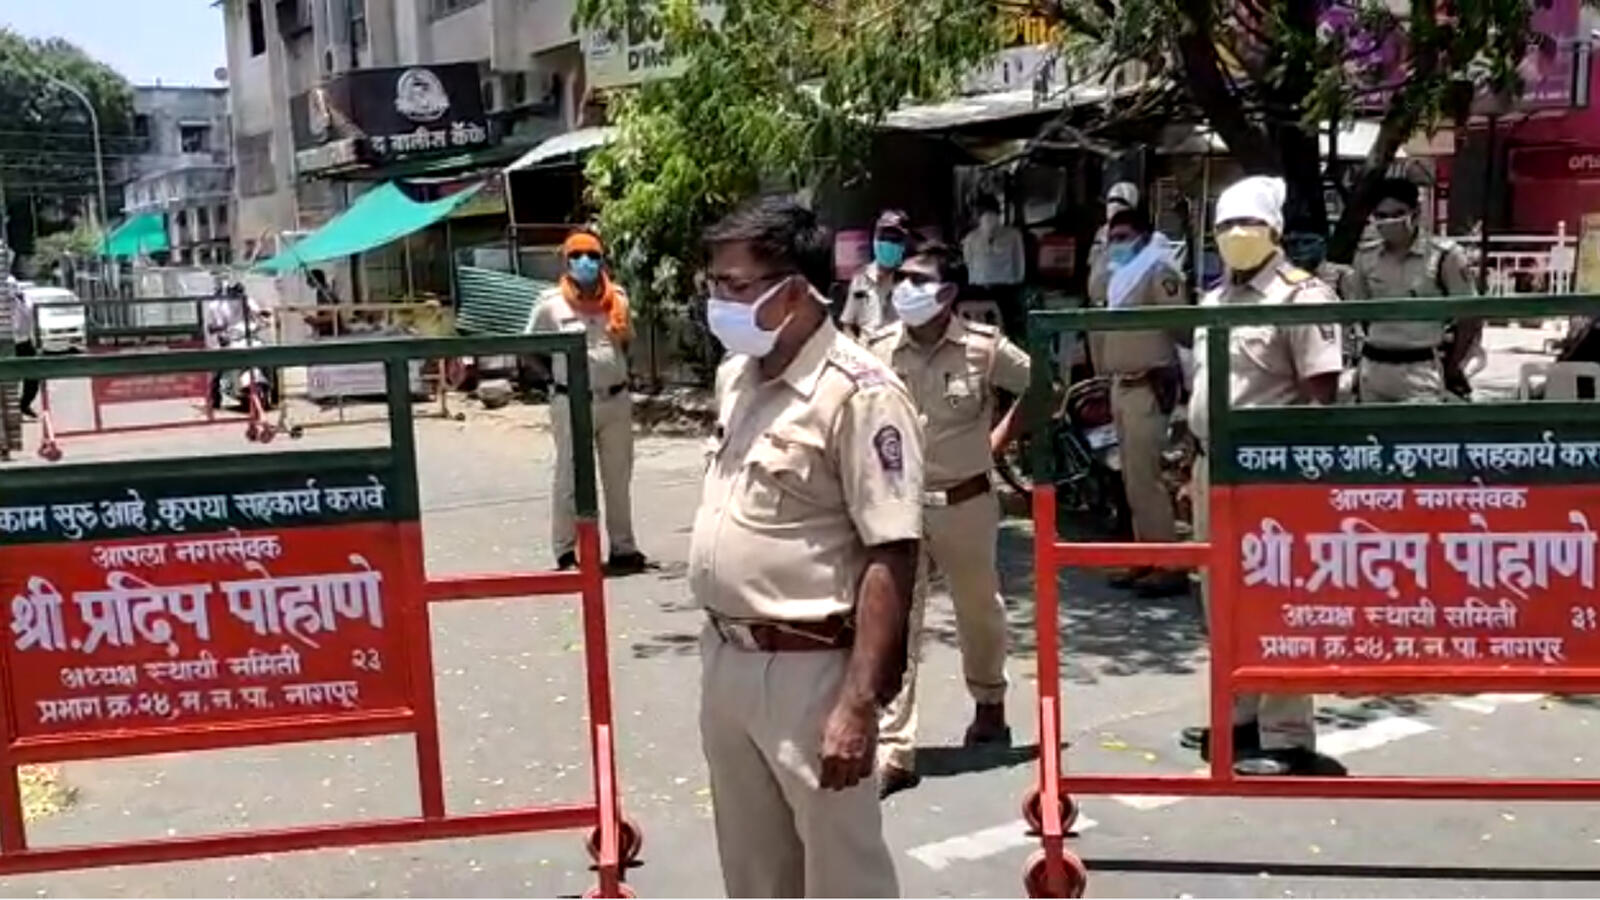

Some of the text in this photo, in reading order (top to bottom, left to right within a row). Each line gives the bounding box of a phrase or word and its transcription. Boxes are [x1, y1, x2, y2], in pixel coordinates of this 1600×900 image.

[1237, 446, 1288, 471] काम
[1292, 446, 1335, 480] सुरु
[1464, 430, 1557, 474] सहकार्य
[0, 505, 46, 532] काम
[52, 502, 99, 540] सुरु
[232, 478, 321, 523] सहकार्य
[324, 475, 386, 511] करावे
[1329, 476, 1529, 512] आपला नगरसेवक
[92, 526, 282, 569] आपला नगरसेवक
[1438, 510, 1598, 600] पोहाणे
[219, 553, 385, 649] पोहाणे
[1281, 603, 1355, 627] अध्यक्ष
[1363, 597, 1436, 628] स्थायी
[1443, 597, 1517, 628] समिती
[61, 644, 382, 689] अध्यक्ष स्थायी समिती २३
[1259, 636, 1316, 660] प्रभाग
[1488, 637, 1565, 664] नागपूर
[37, 697, 103, 724] प्रभाग
[281, 680, 359, 709] नागपूर
